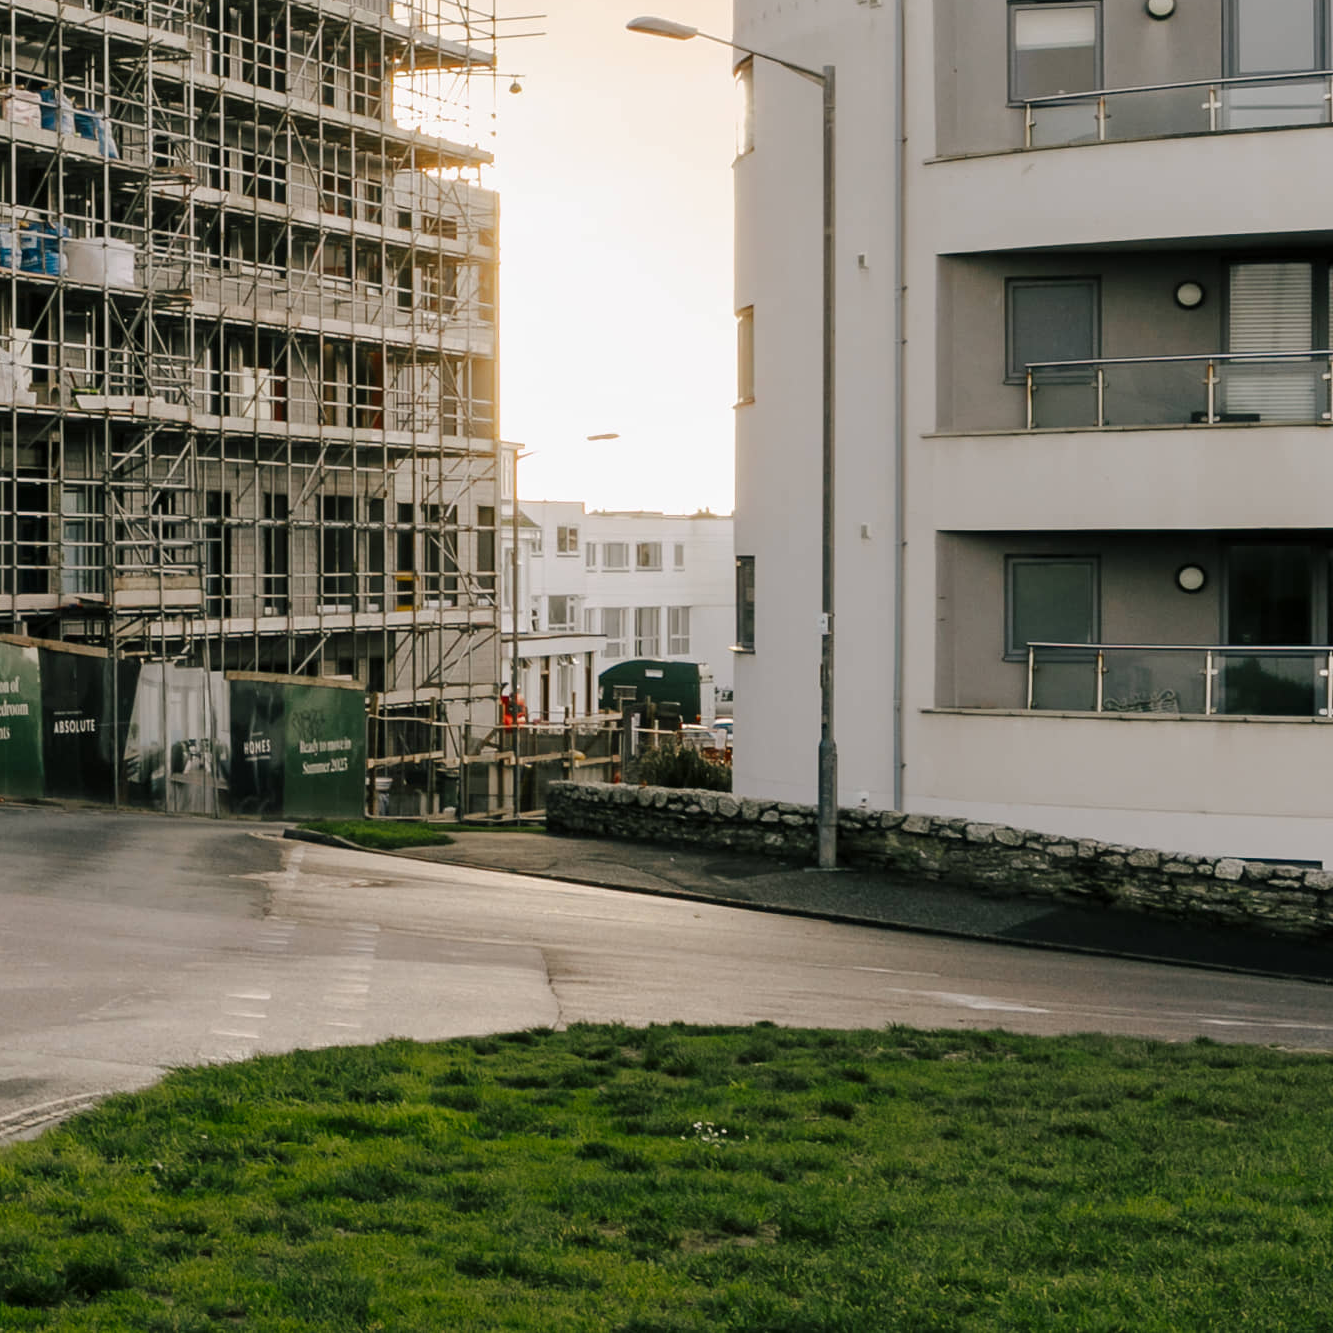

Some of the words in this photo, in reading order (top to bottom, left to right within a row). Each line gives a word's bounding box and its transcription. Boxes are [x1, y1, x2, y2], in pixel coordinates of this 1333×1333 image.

[10, 675, 21, 693] of
[53, 719, 96, 734] ABSOLUTE
[243, 739, 271, 755] HOMES
